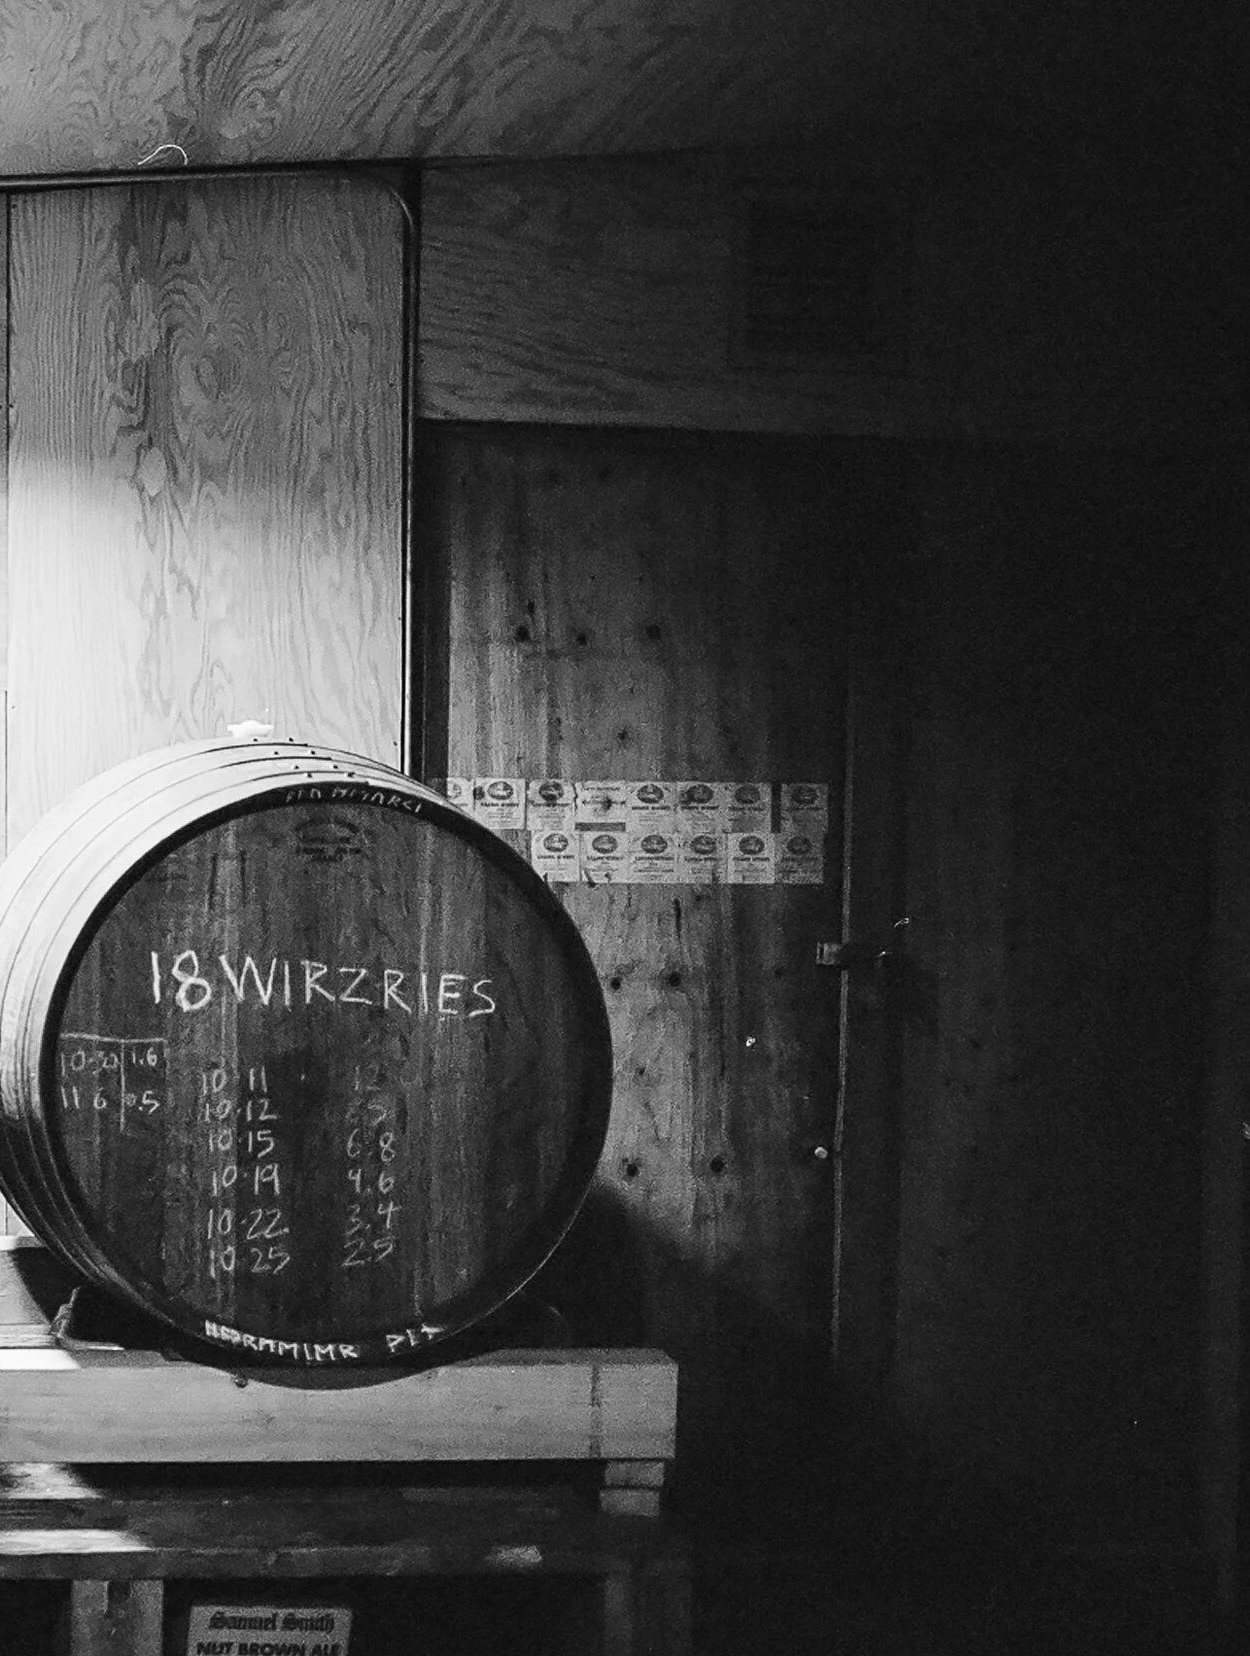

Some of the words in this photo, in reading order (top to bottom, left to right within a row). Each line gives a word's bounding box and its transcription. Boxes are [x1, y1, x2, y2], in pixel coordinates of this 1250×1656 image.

[208, 1611, 278, 1631] Samuel
[282, 1612, 335, 1634] Smith
[237, 1642, 306, 1656] BROWN
